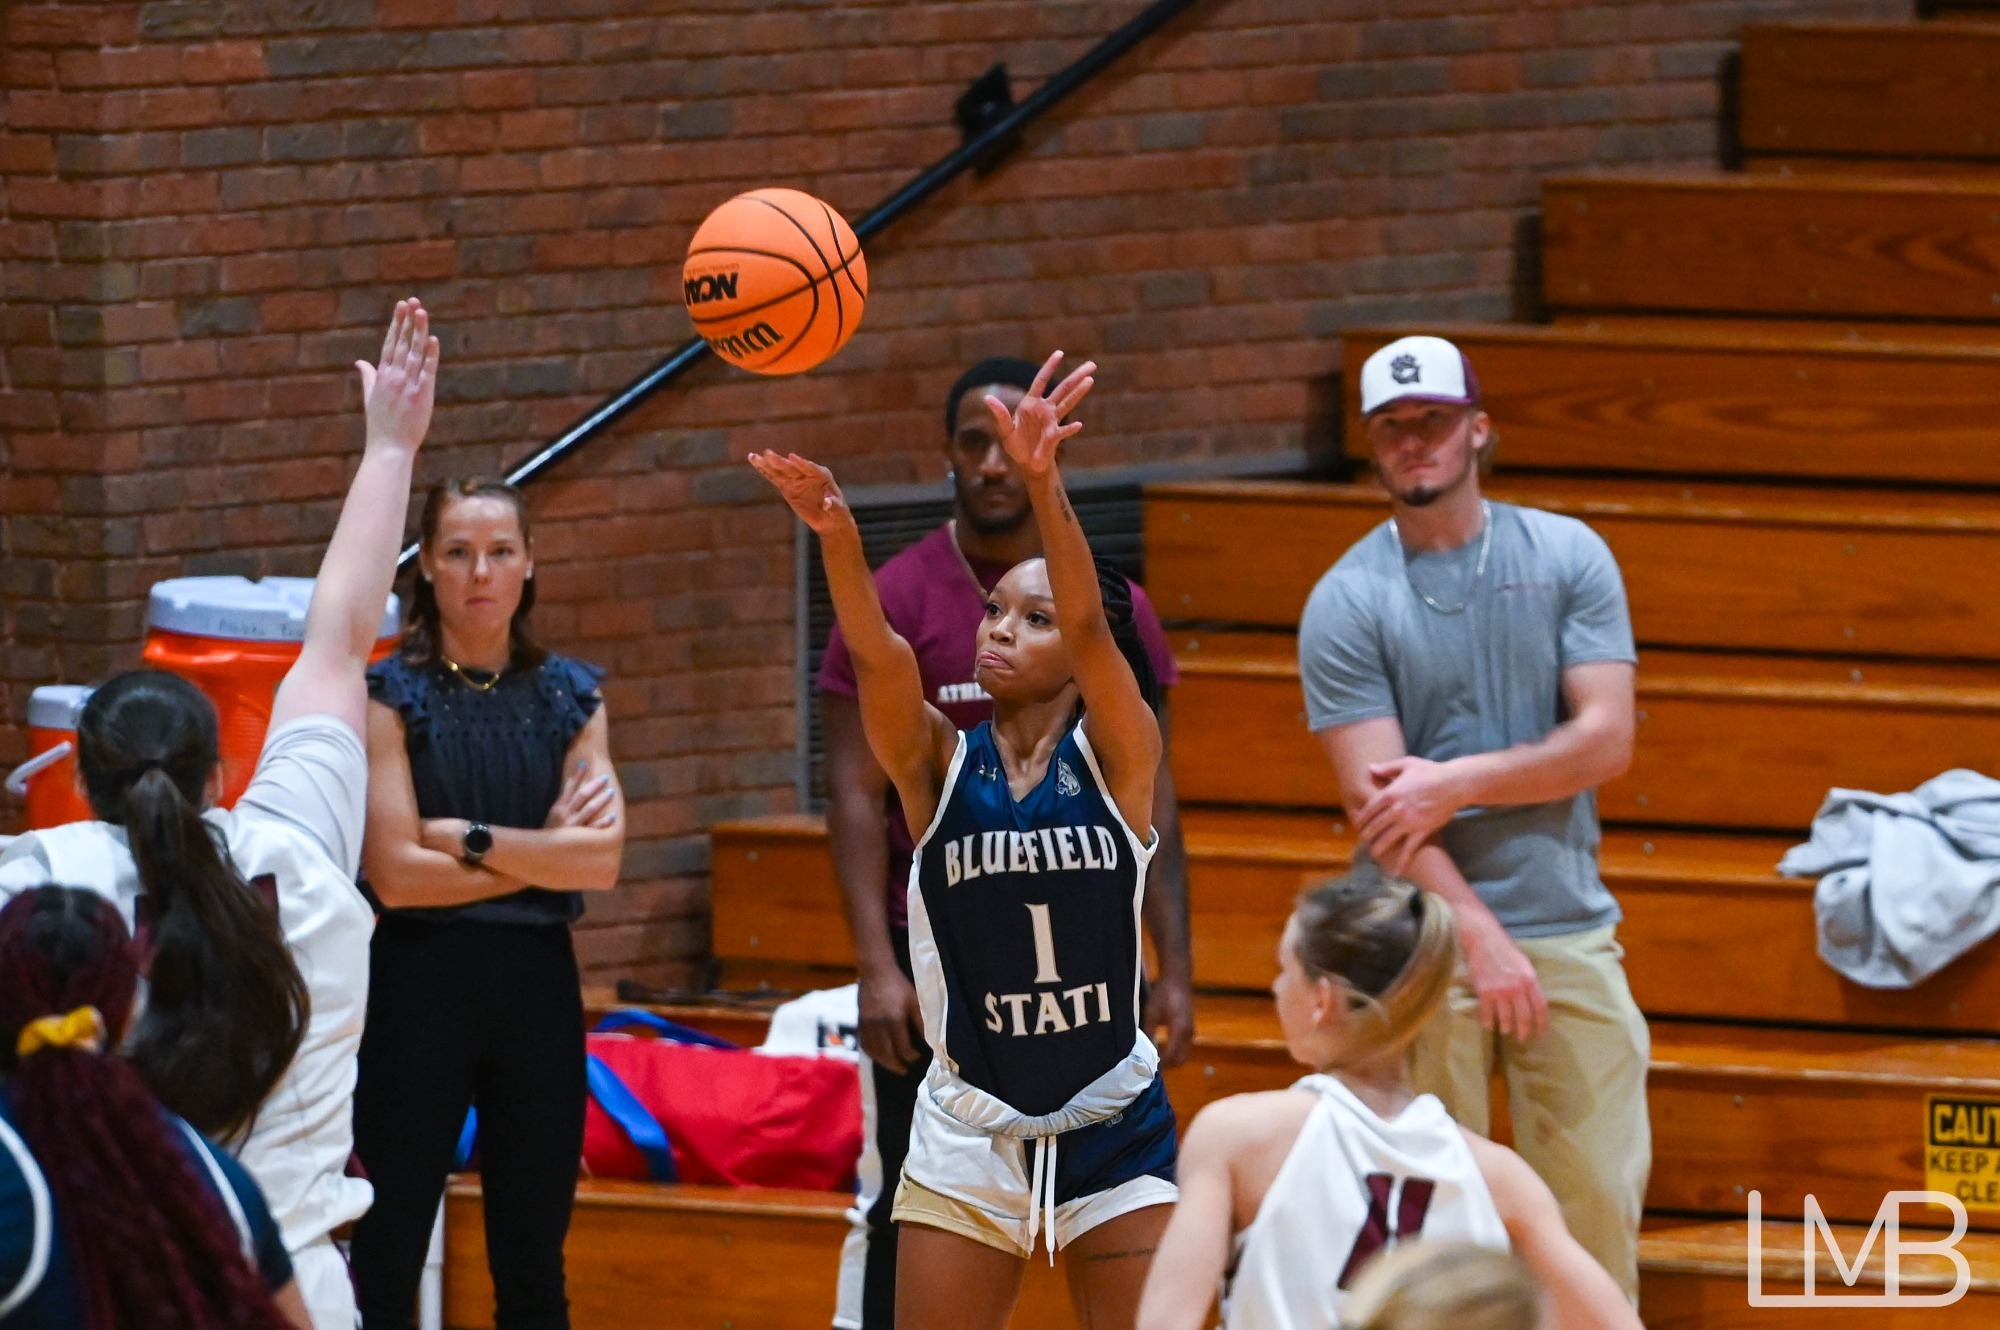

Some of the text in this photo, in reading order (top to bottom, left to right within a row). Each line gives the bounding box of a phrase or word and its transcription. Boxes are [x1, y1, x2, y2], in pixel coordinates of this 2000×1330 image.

[944, 825, 1118, 888] BLUEFIELD
[1024, 902, 1062, 984] 1
[1930, 1150, 1989, 1173] KEEP
